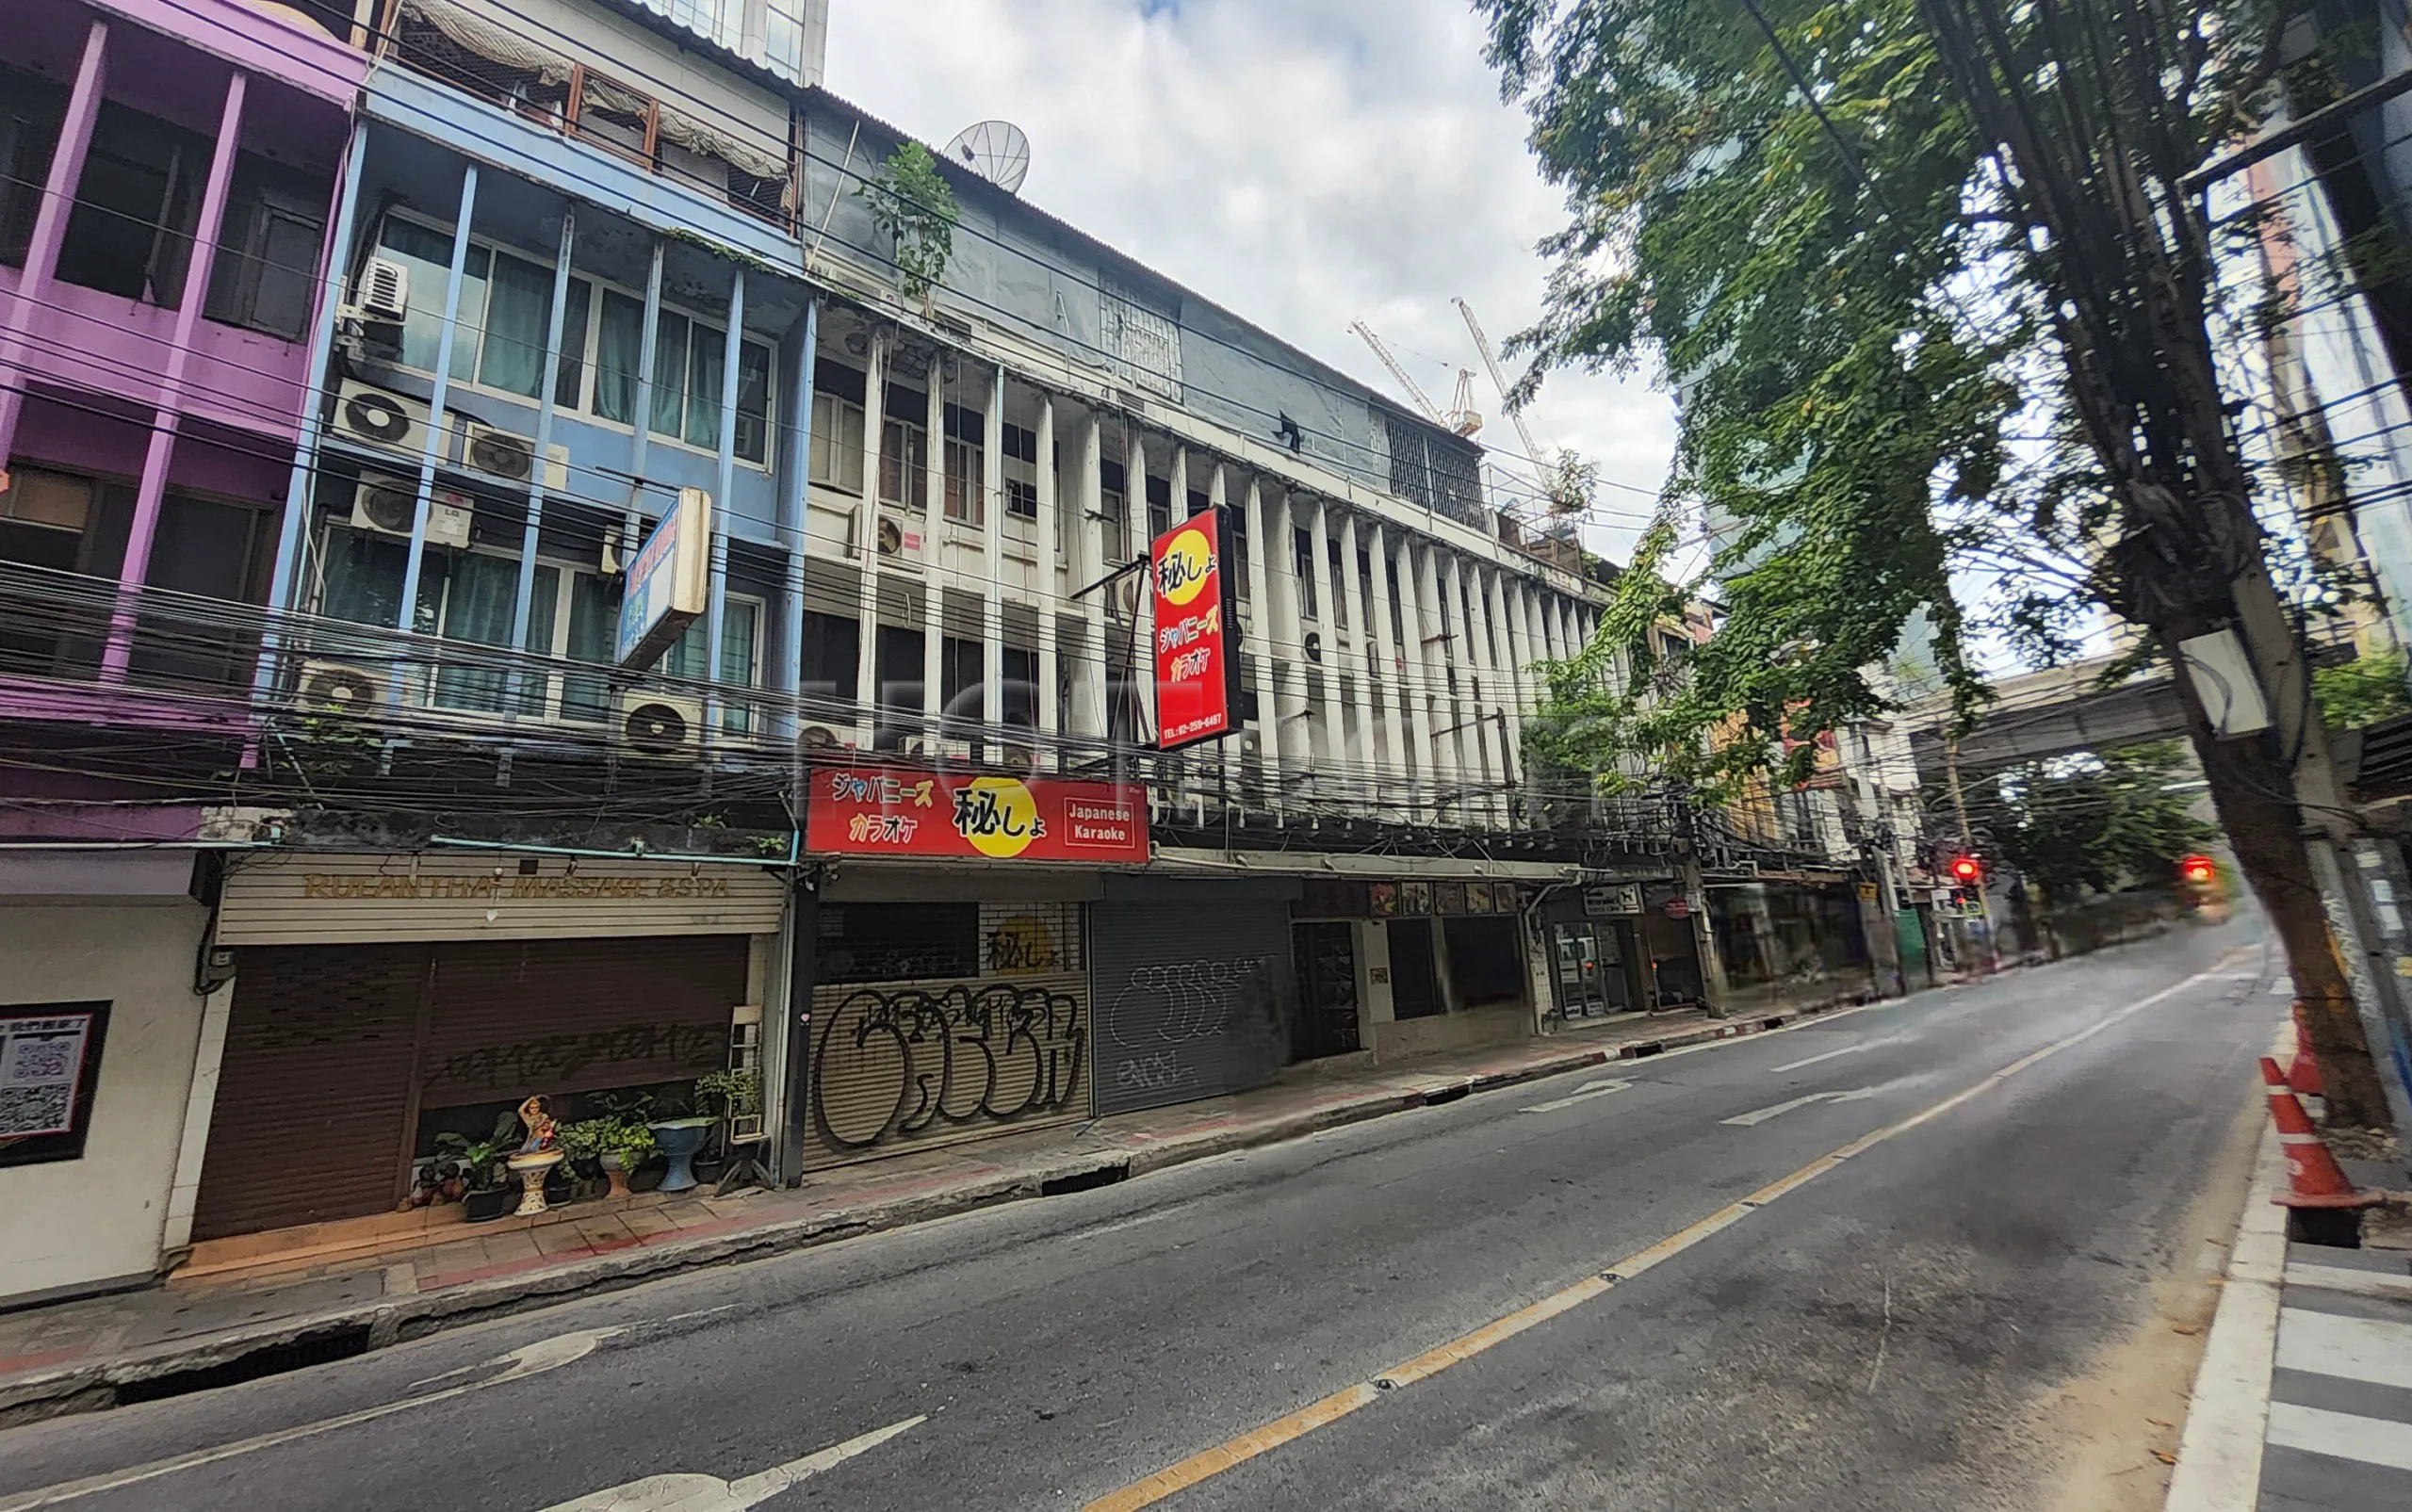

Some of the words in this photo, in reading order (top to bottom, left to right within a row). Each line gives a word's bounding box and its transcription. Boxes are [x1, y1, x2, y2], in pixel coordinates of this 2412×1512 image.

[1170, 647, 1211, 683] カラオケ
[1068, 803, 1131, 822] Japanese
[850, 813, 918, 844] カラオケ
[1074, 823, 1126, 841] Karaoke
[304, 873, 500, 898] RUEANTHA
[512, 876, 649, 898] MASSAGE
